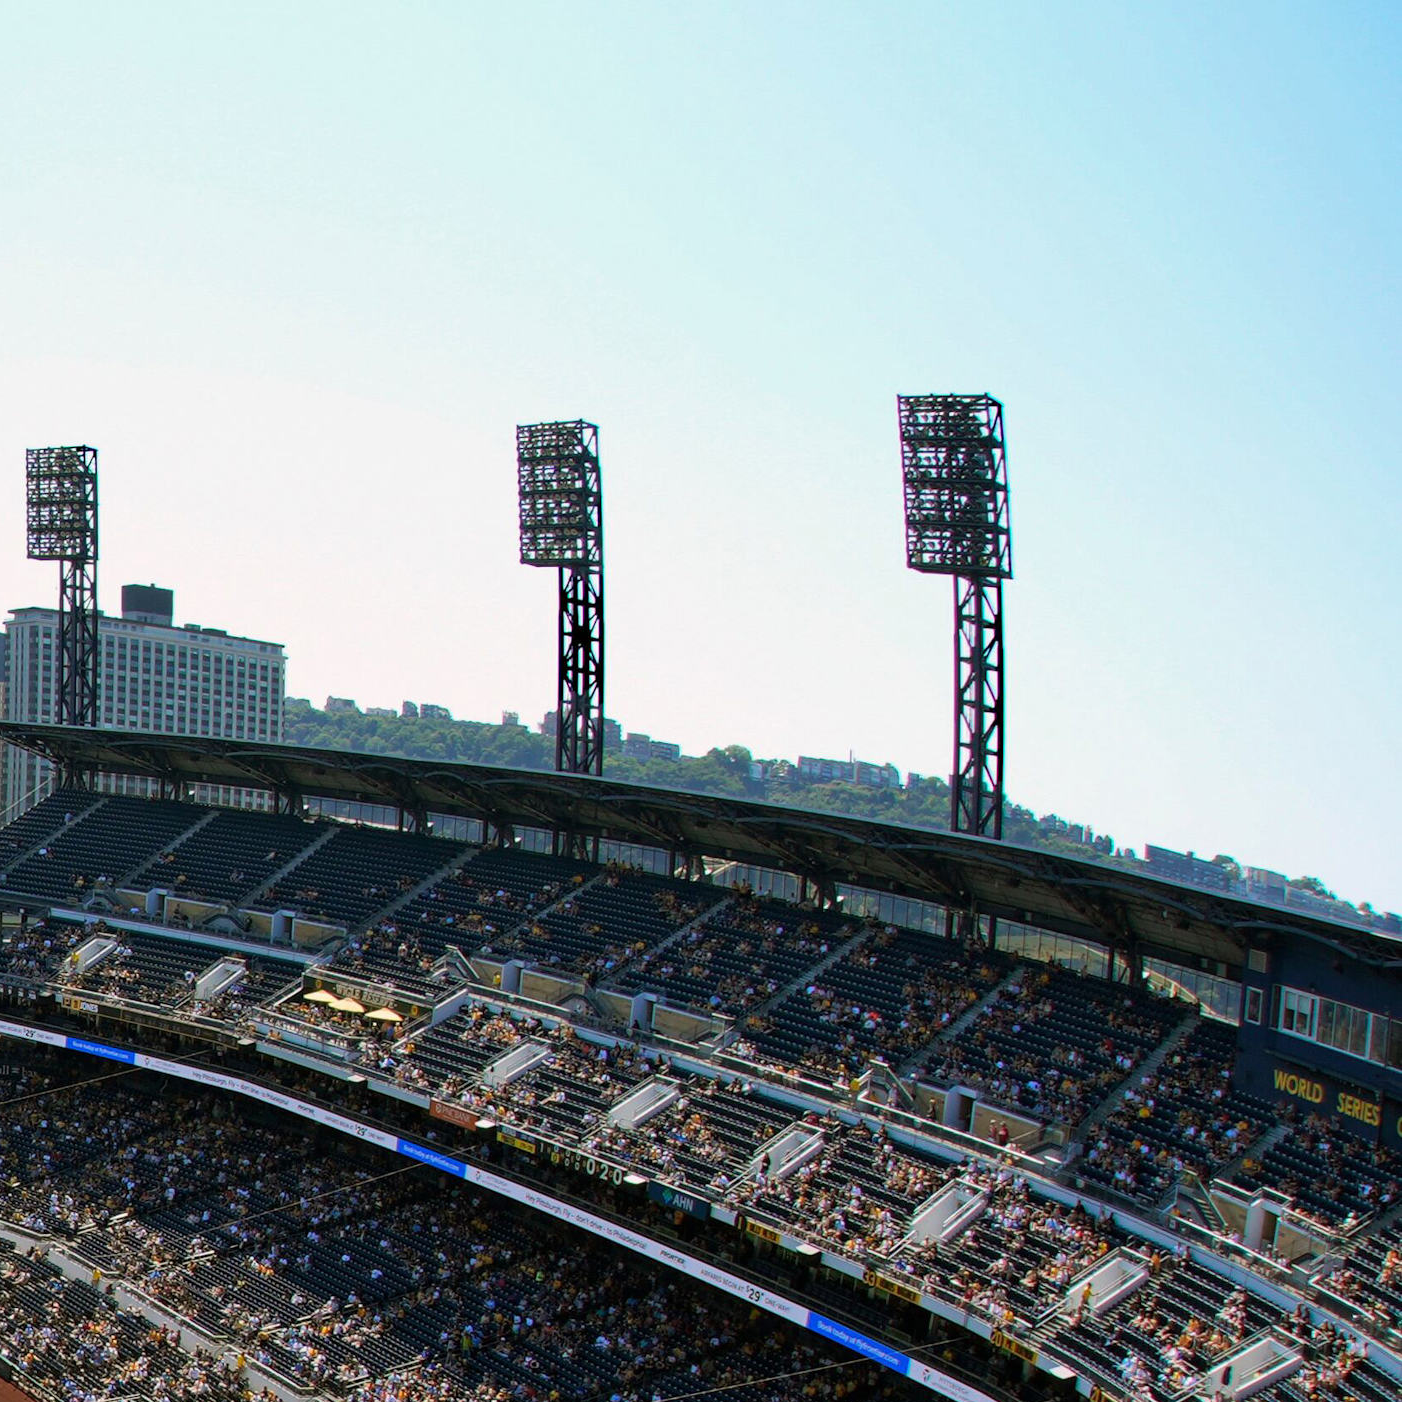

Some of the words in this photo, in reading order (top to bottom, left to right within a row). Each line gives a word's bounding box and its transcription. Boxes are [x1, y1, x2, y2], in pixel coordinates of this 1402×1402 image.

[1273, 1069, 1324, 1105] WORLD
[1336, 1092, 1382, 1128] SERIES
[673, 1193, 695, 1213] AHN
[829, 1324, 850, 1341] today
